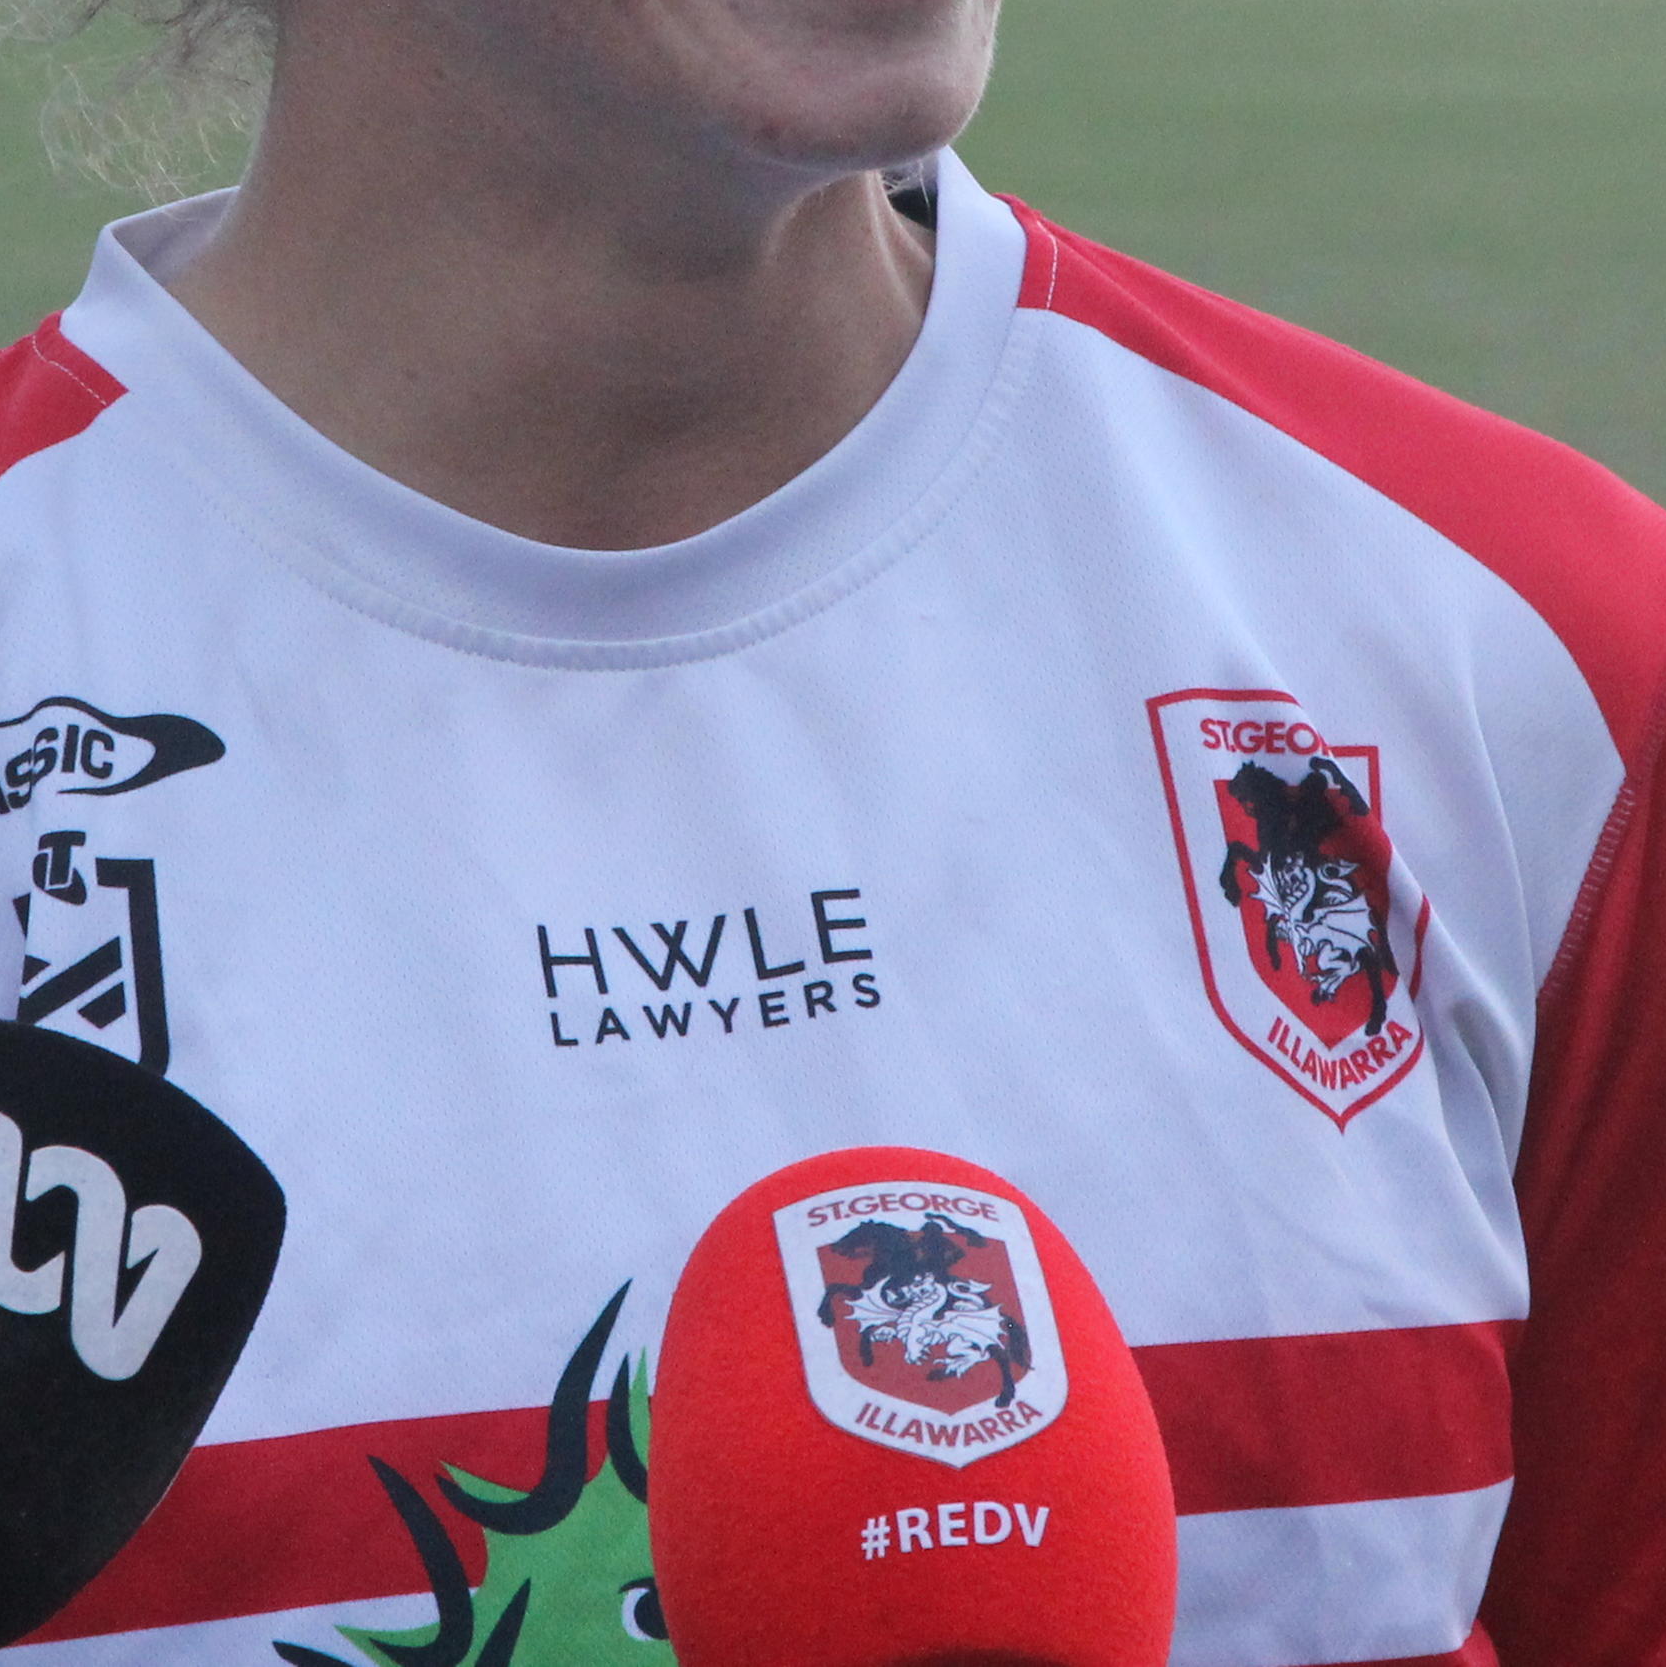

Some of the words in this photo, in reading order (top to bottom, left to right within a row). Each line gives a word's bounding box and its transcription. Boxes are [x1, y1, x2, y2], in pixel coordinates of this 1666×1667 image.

[537, 889, 873, 998] HWLE
[550, 973, 881, 1047] LAWYERS
[1267, 1016, 1414, 1091] ILLAWARRA
[807, 1192, 1001, 1228] ST.GEORGE
[855, 1400, 1043, 1449] ILLAWARRA
[861, 1501, 1050, 1560] #REDV
